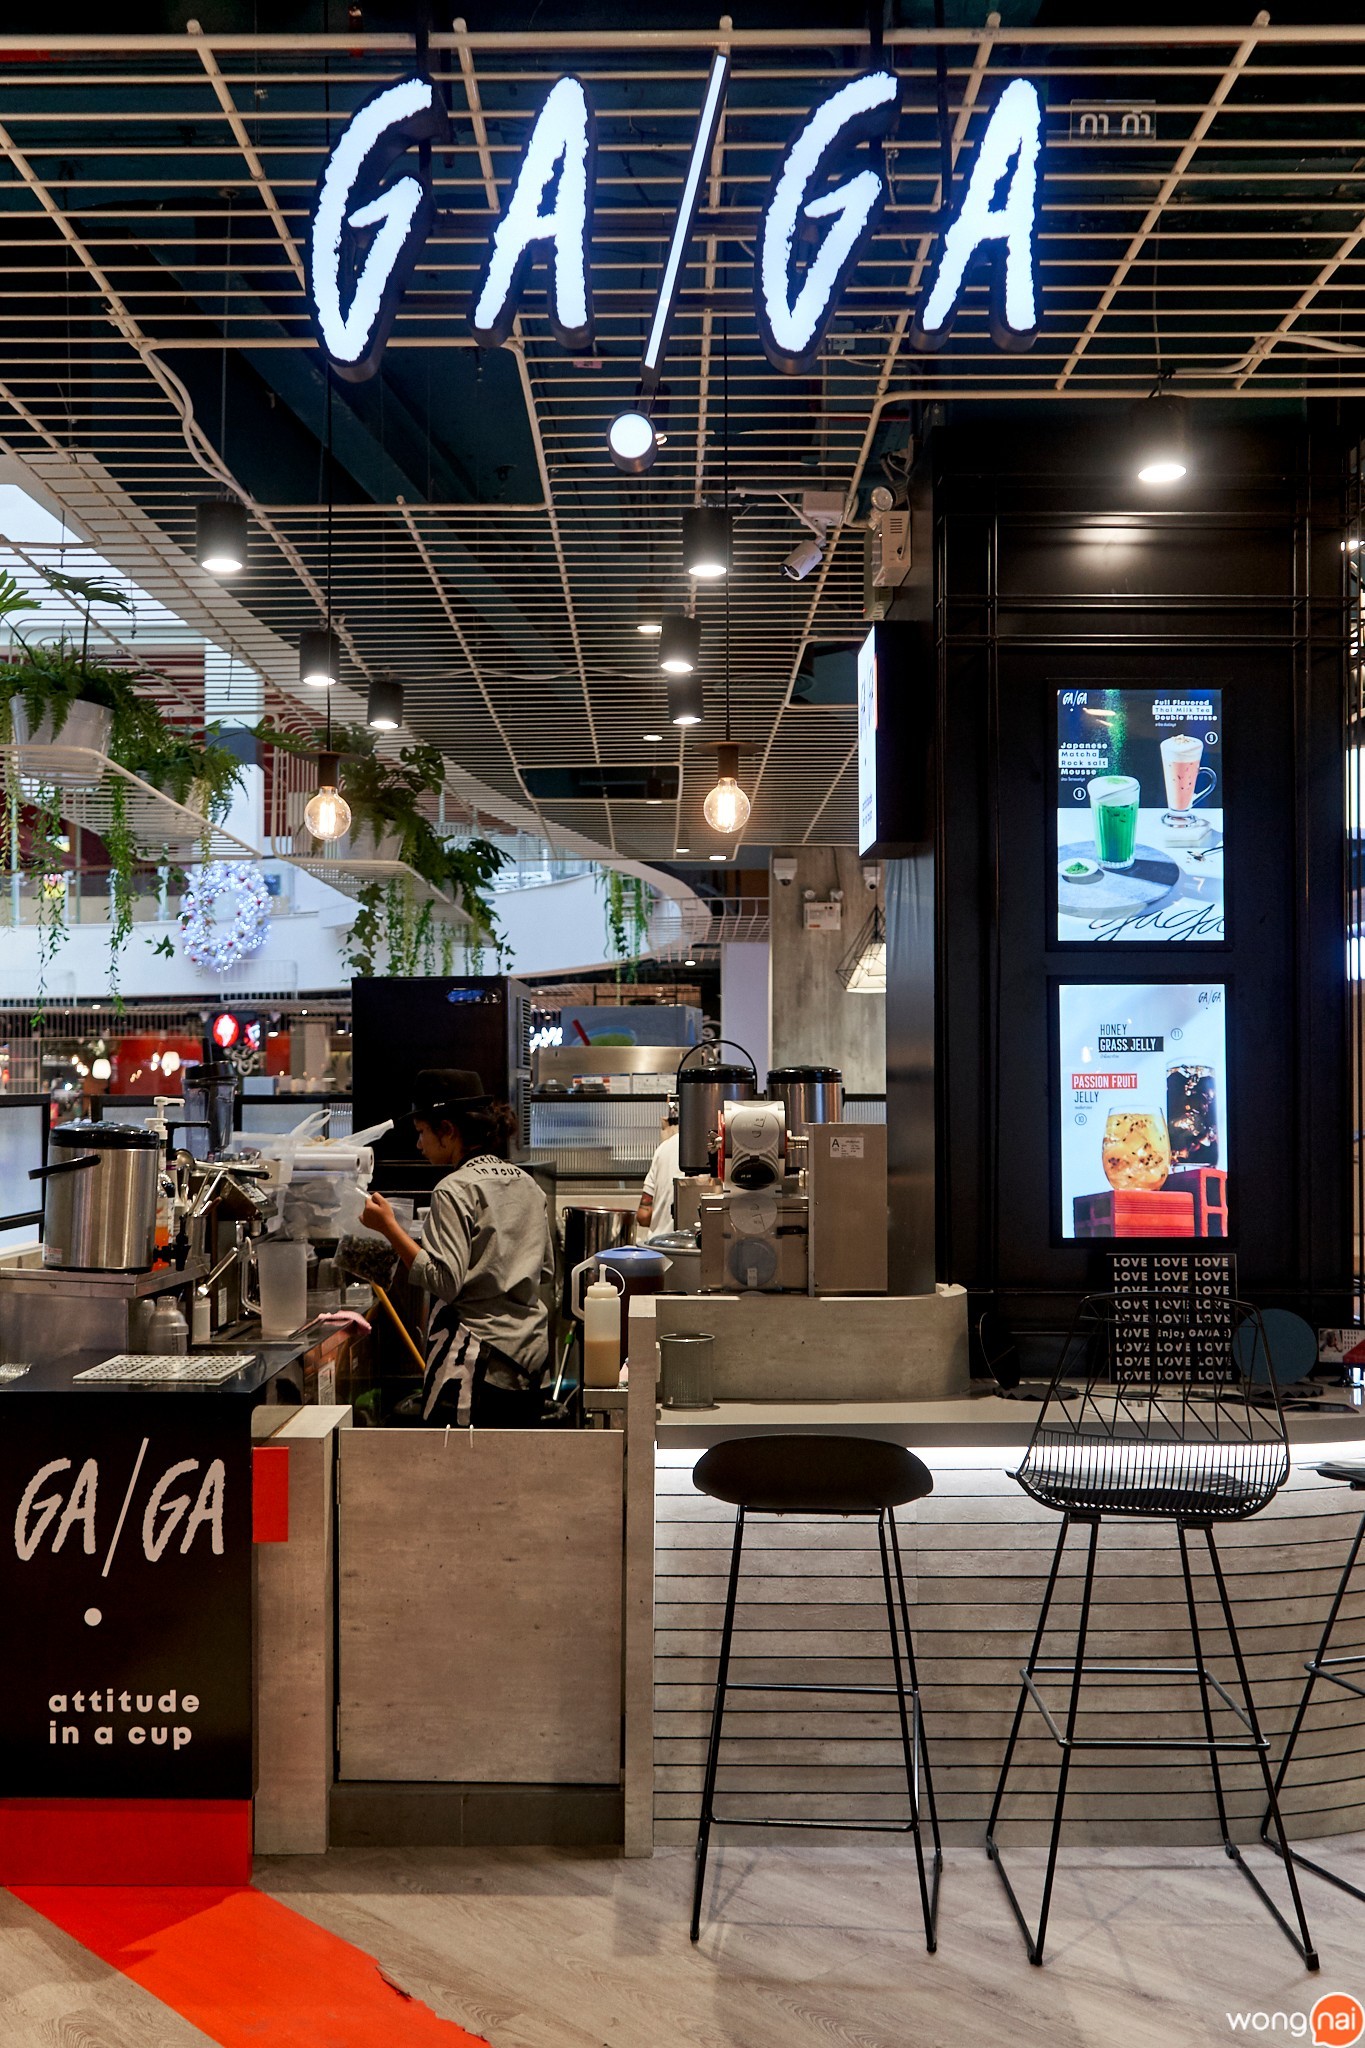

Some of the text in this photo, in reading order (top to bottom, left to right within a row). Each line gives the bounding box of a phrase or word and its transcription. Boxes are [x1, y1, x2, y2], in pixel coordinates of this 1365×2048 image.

[1060, 742, 1108, 751] Japanese
[1060, 768, 1097, 776] Mousse
[1099, 1023, 1128, 1036] HONEY
[1099, 1038, 1157, 1051] GRASS JELLY
[1073, 1075, 1137, 1088] PASSION FRUIT
[1073, 1091, 1100, 1103] JELLY
[500, 1168, 521, 1177] cup
[1114, 1257, 1229, 1267] LOVE LOVE LOVE
[1114, 1271, 1229, 1281] LOVE LOVE LOVE
[48, 1688, 200, 1713] attitude
[49, 1720, 192, 1750] in a cup
